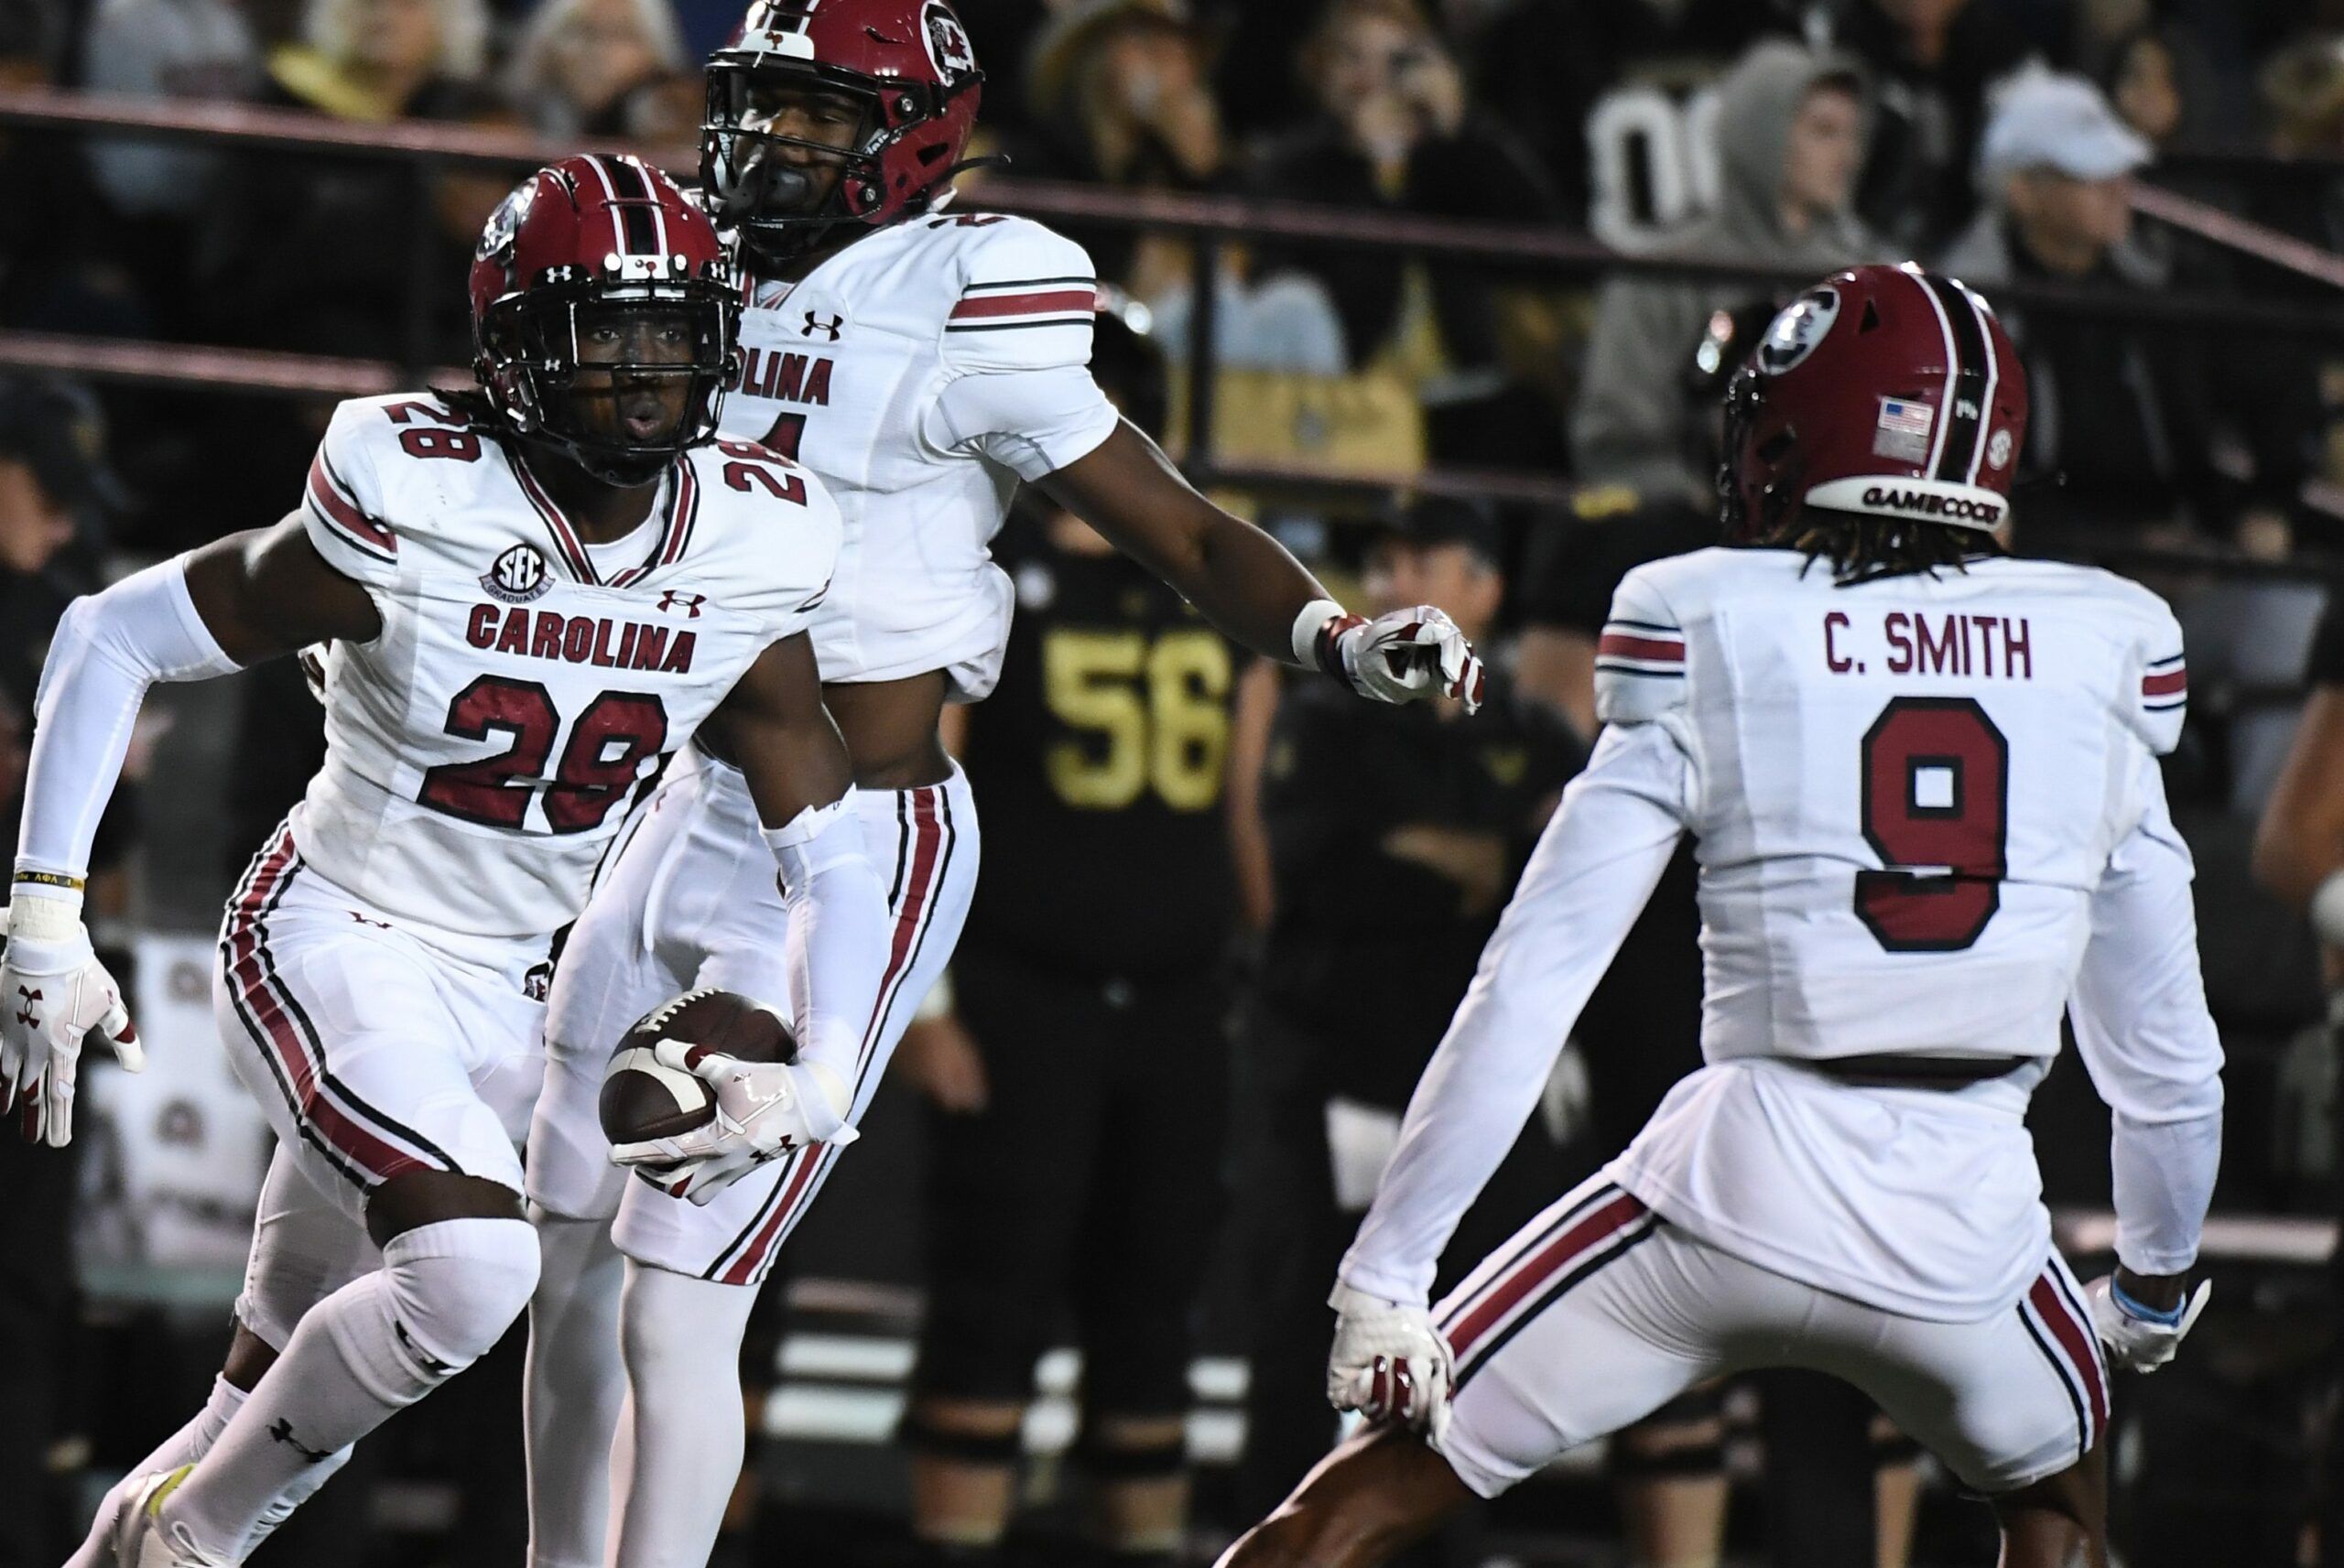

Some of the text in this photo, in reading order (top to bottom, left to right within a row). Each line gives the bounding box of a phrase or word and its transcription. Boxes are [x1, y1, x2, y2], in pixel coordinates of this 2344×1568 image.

[380, 401, 483, 463] 28
[486, 585, 545, 604] GRADUATE
[498, 546, 542, 589] SEC
[466, 603, 697, 674] CAROLINA
[1824, 611, 2032, 680] C. SMITH
[1043, 629, 1232, 812] 56
[1853, 696, 2009, 953] 9
